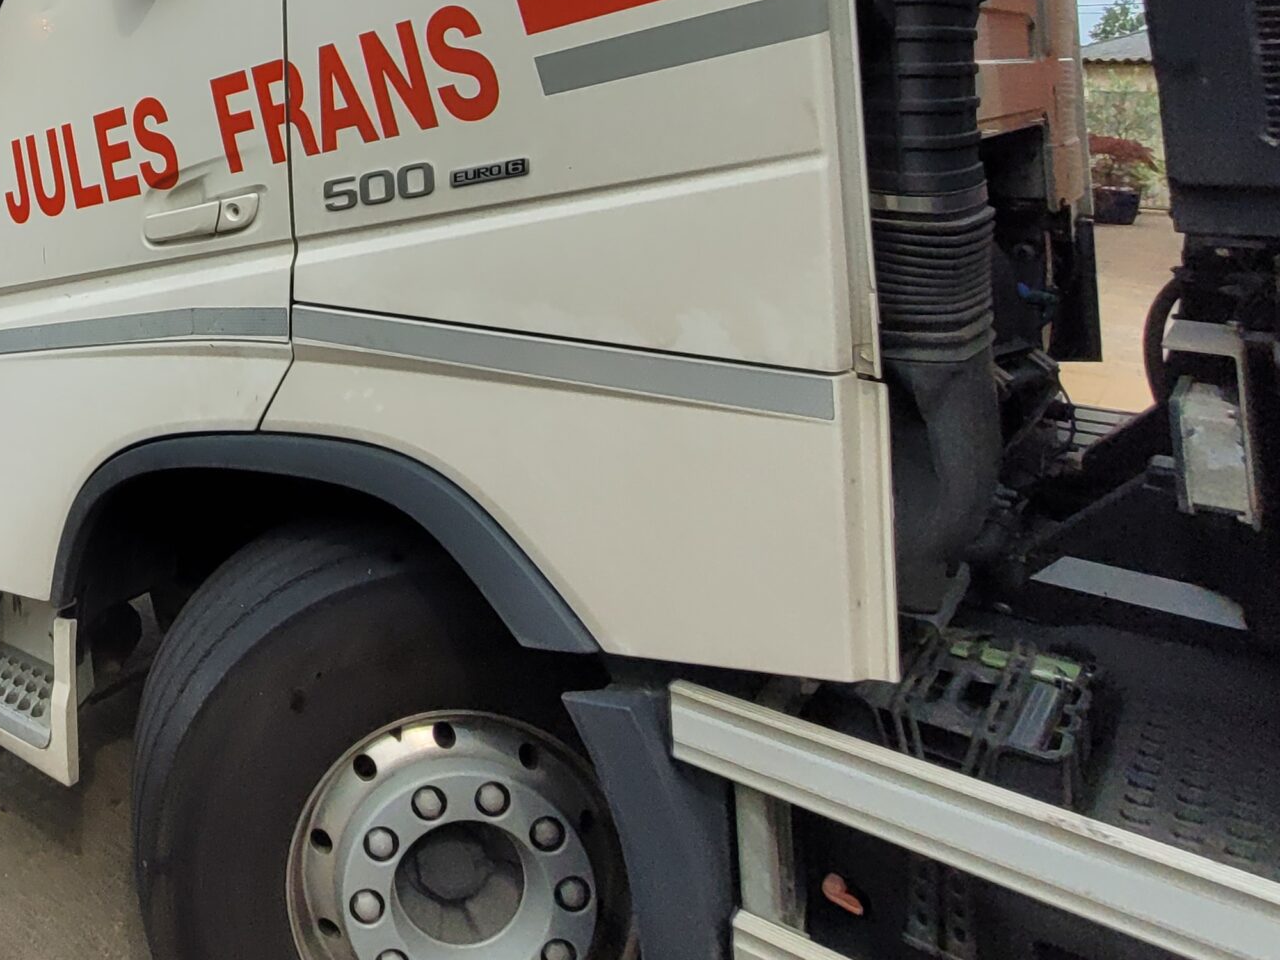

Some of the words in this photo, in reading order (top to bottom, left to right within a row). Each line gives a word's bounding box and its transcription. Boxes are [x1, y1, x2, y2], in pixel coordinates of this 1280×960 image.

[4, 96, 180, 224] JULES
[209, 3, 501, 175] FRANS
[323, 161, 436, 212] 500
[453, 164, 502, 184] EURO
